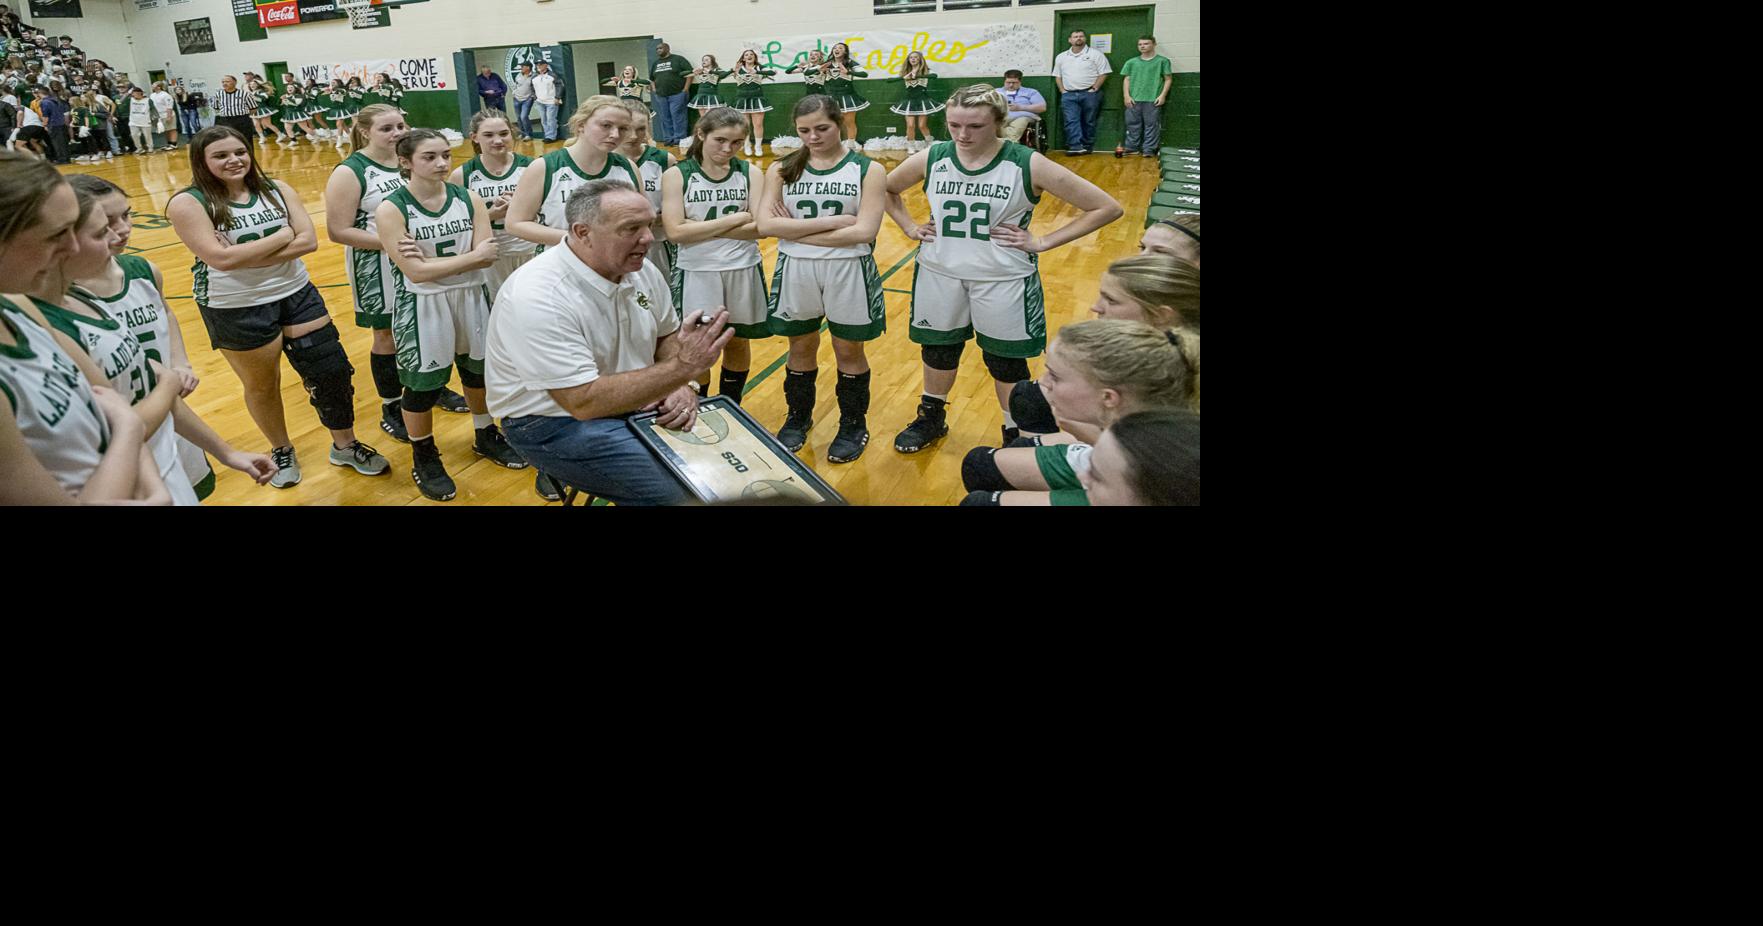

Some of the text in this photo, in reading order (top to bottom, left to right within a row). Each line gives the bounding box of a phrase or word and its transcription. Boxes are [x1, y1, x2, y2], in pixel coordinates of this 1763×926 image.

[400, 58, 438, 76] COME
[402, 76, 438, 90] TRUE
[687, 188, 747, 203] LADY EAGLE
[815, 182, 858, 197] EAGLES
[935, 181, 1012, 200] LADY EAGLES
[942, 199, 991, 241] 22
[721, 451, 749, 473] OCS
